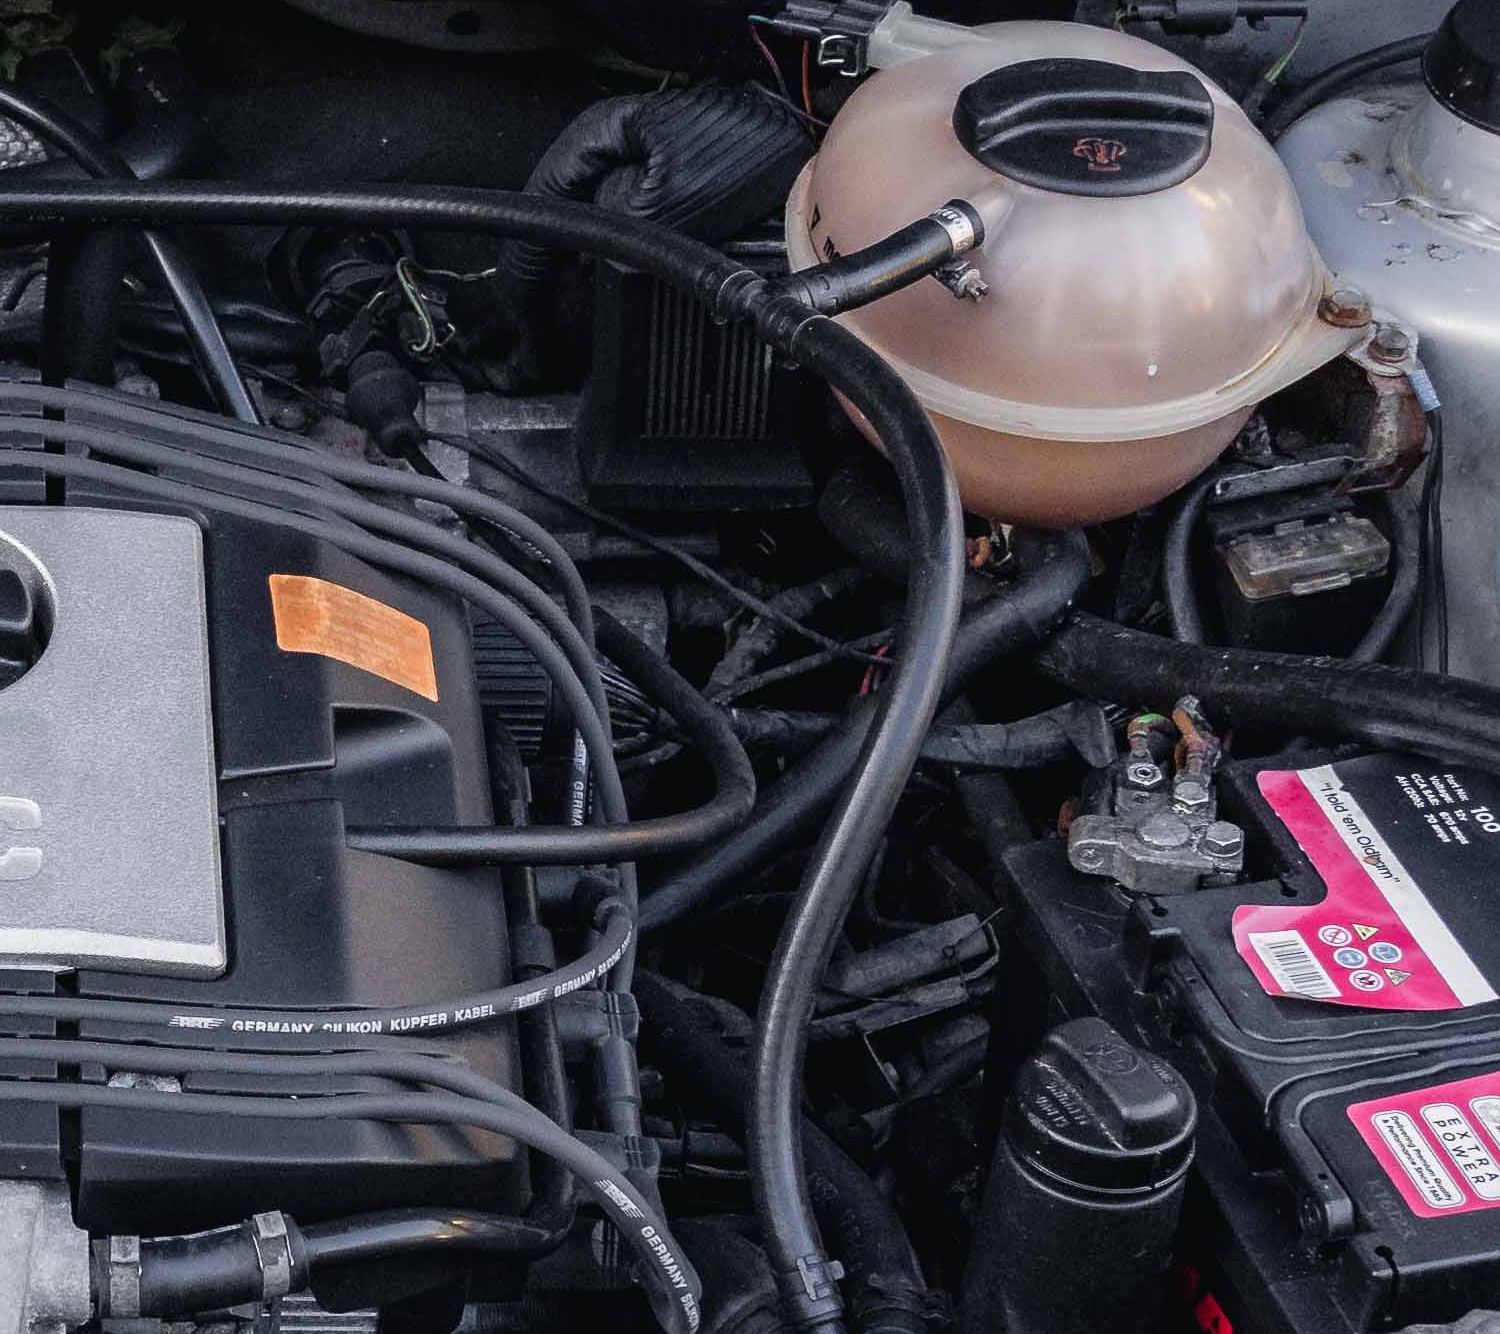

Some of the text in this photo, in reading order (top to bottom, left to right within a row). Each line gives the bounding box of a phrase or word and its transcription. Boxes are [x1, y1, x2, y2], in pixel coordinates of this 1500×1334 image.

[570, 780, 585, 828] GERMA
[231, 1019, 315, 1034] GERMANY
[389, 1012, 449, 1033] KUPFER
[453, 1003, 498, 1023] KABEL
[553, 969, 597, 998] GERMANY
[1432, 1119, 1487, 1185] POWER
[1446, 1117, 1500, 1183] EXTRA
[640, 1225, 688, 1290] GERMANY
